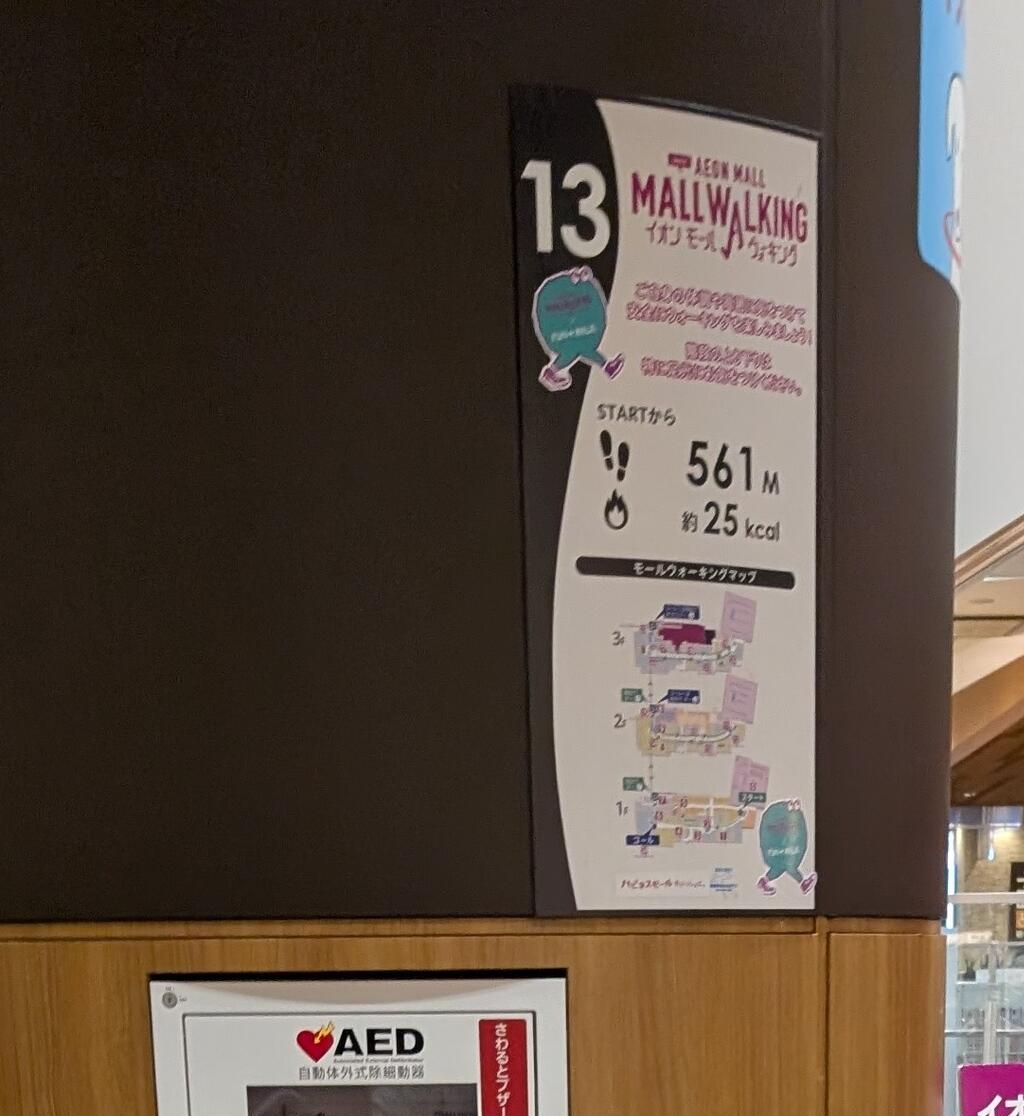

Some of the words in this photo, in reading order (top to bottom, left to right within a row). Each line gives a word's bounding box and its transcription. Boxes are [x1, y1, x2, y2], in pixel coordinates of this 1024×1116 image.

[695, 157, 729, 179] AEON
[733, 163, 766, 188] MALL
[520, 159, 611, 259] 13
[597, 403, 676, 426] STARTから
[686, 440, 752, 492] 561
[761, 470, 780, 495] M
[703, 500, 738, 536] 25
[745, 517, 781, 542] kcal
[334, 1028, 424, 1056] AED
[299, 1065, 424, 1081] 自動体外式除細動器
